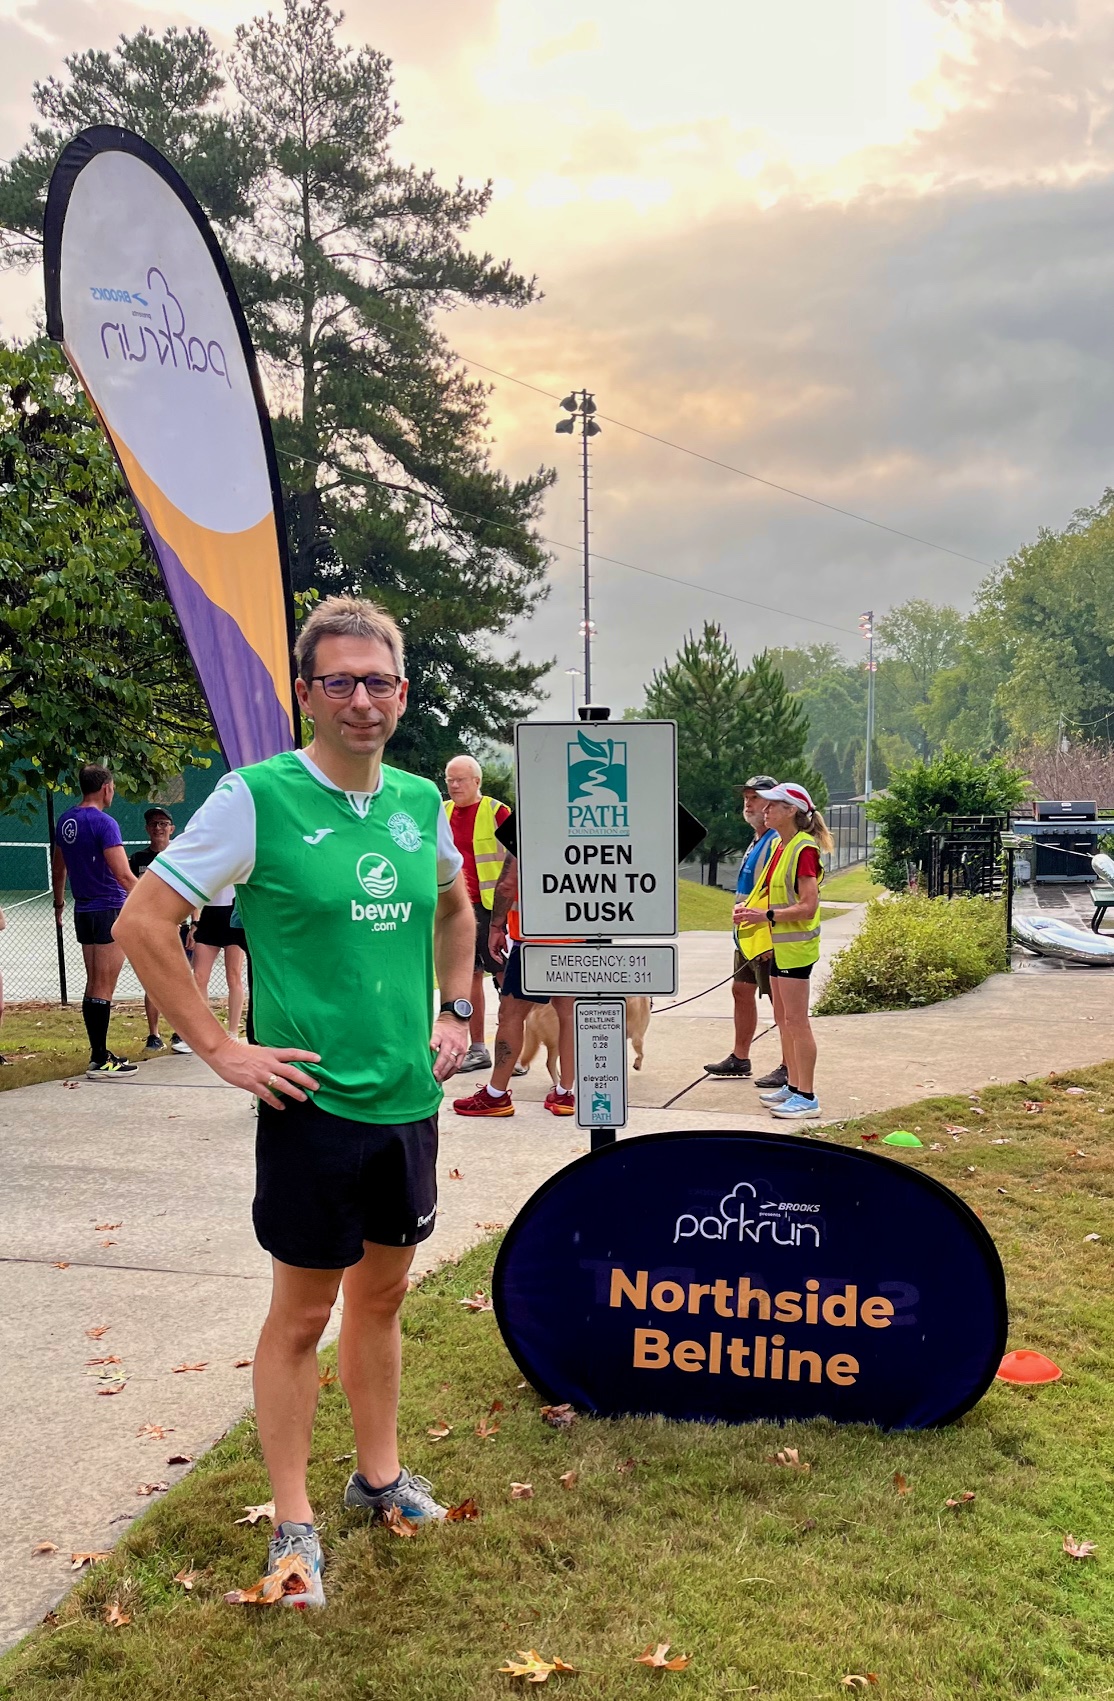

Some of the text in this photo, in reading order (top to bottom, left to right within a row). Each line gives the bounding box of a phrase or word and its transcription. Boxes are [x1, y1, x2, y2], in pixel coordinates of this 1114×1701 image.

[566, 804, 630, 828] PATH
[564, 844, 632, 865] OPEN
[542, 872, 657, 894] DAWN TO
[350, 900, 412, 923] bevvy
[565, 901, 635, 922] DUSK
[371, 921, 396, 931] .com
[550, 955, 647, 968] EMERGENCY: 911
[546, 971, 652, 983] MAINTENANCE: 311
[583, 1074, 619, 1082] elevation
[592, 1113, 612, 1121] PATH
[673, 1182, 820, 1248] parkrun
[778, 1202, 821, 1213] BROOKS
[609, 1268, 895, 1329] Northside
[632, 1327, 860, 1387] Beltline
